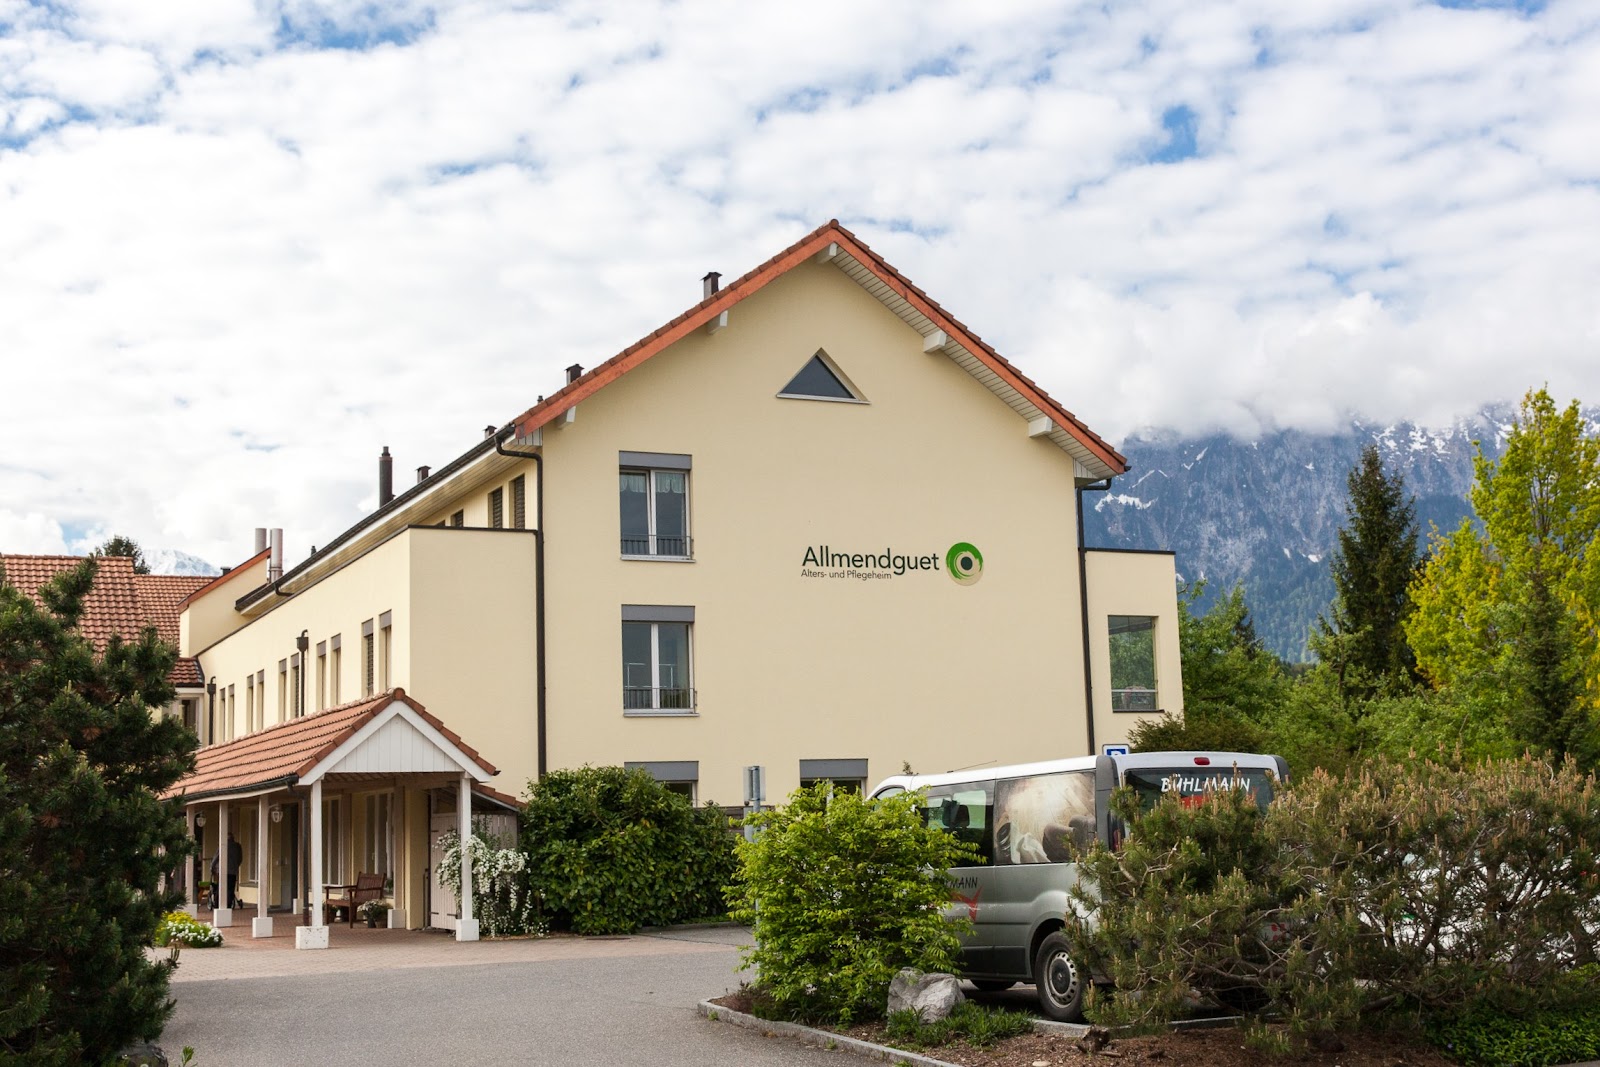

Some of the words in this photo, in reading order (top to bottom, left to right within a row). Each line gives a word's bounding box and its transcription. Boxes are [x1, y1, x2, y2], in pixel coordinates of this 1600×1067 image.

[802, 545, 940, 576] Allmendguet
[801, 568, 827, 578] Alters-
[829, 569, 845, 579] und
[847, 570, 892, 581] Pflegeheim
